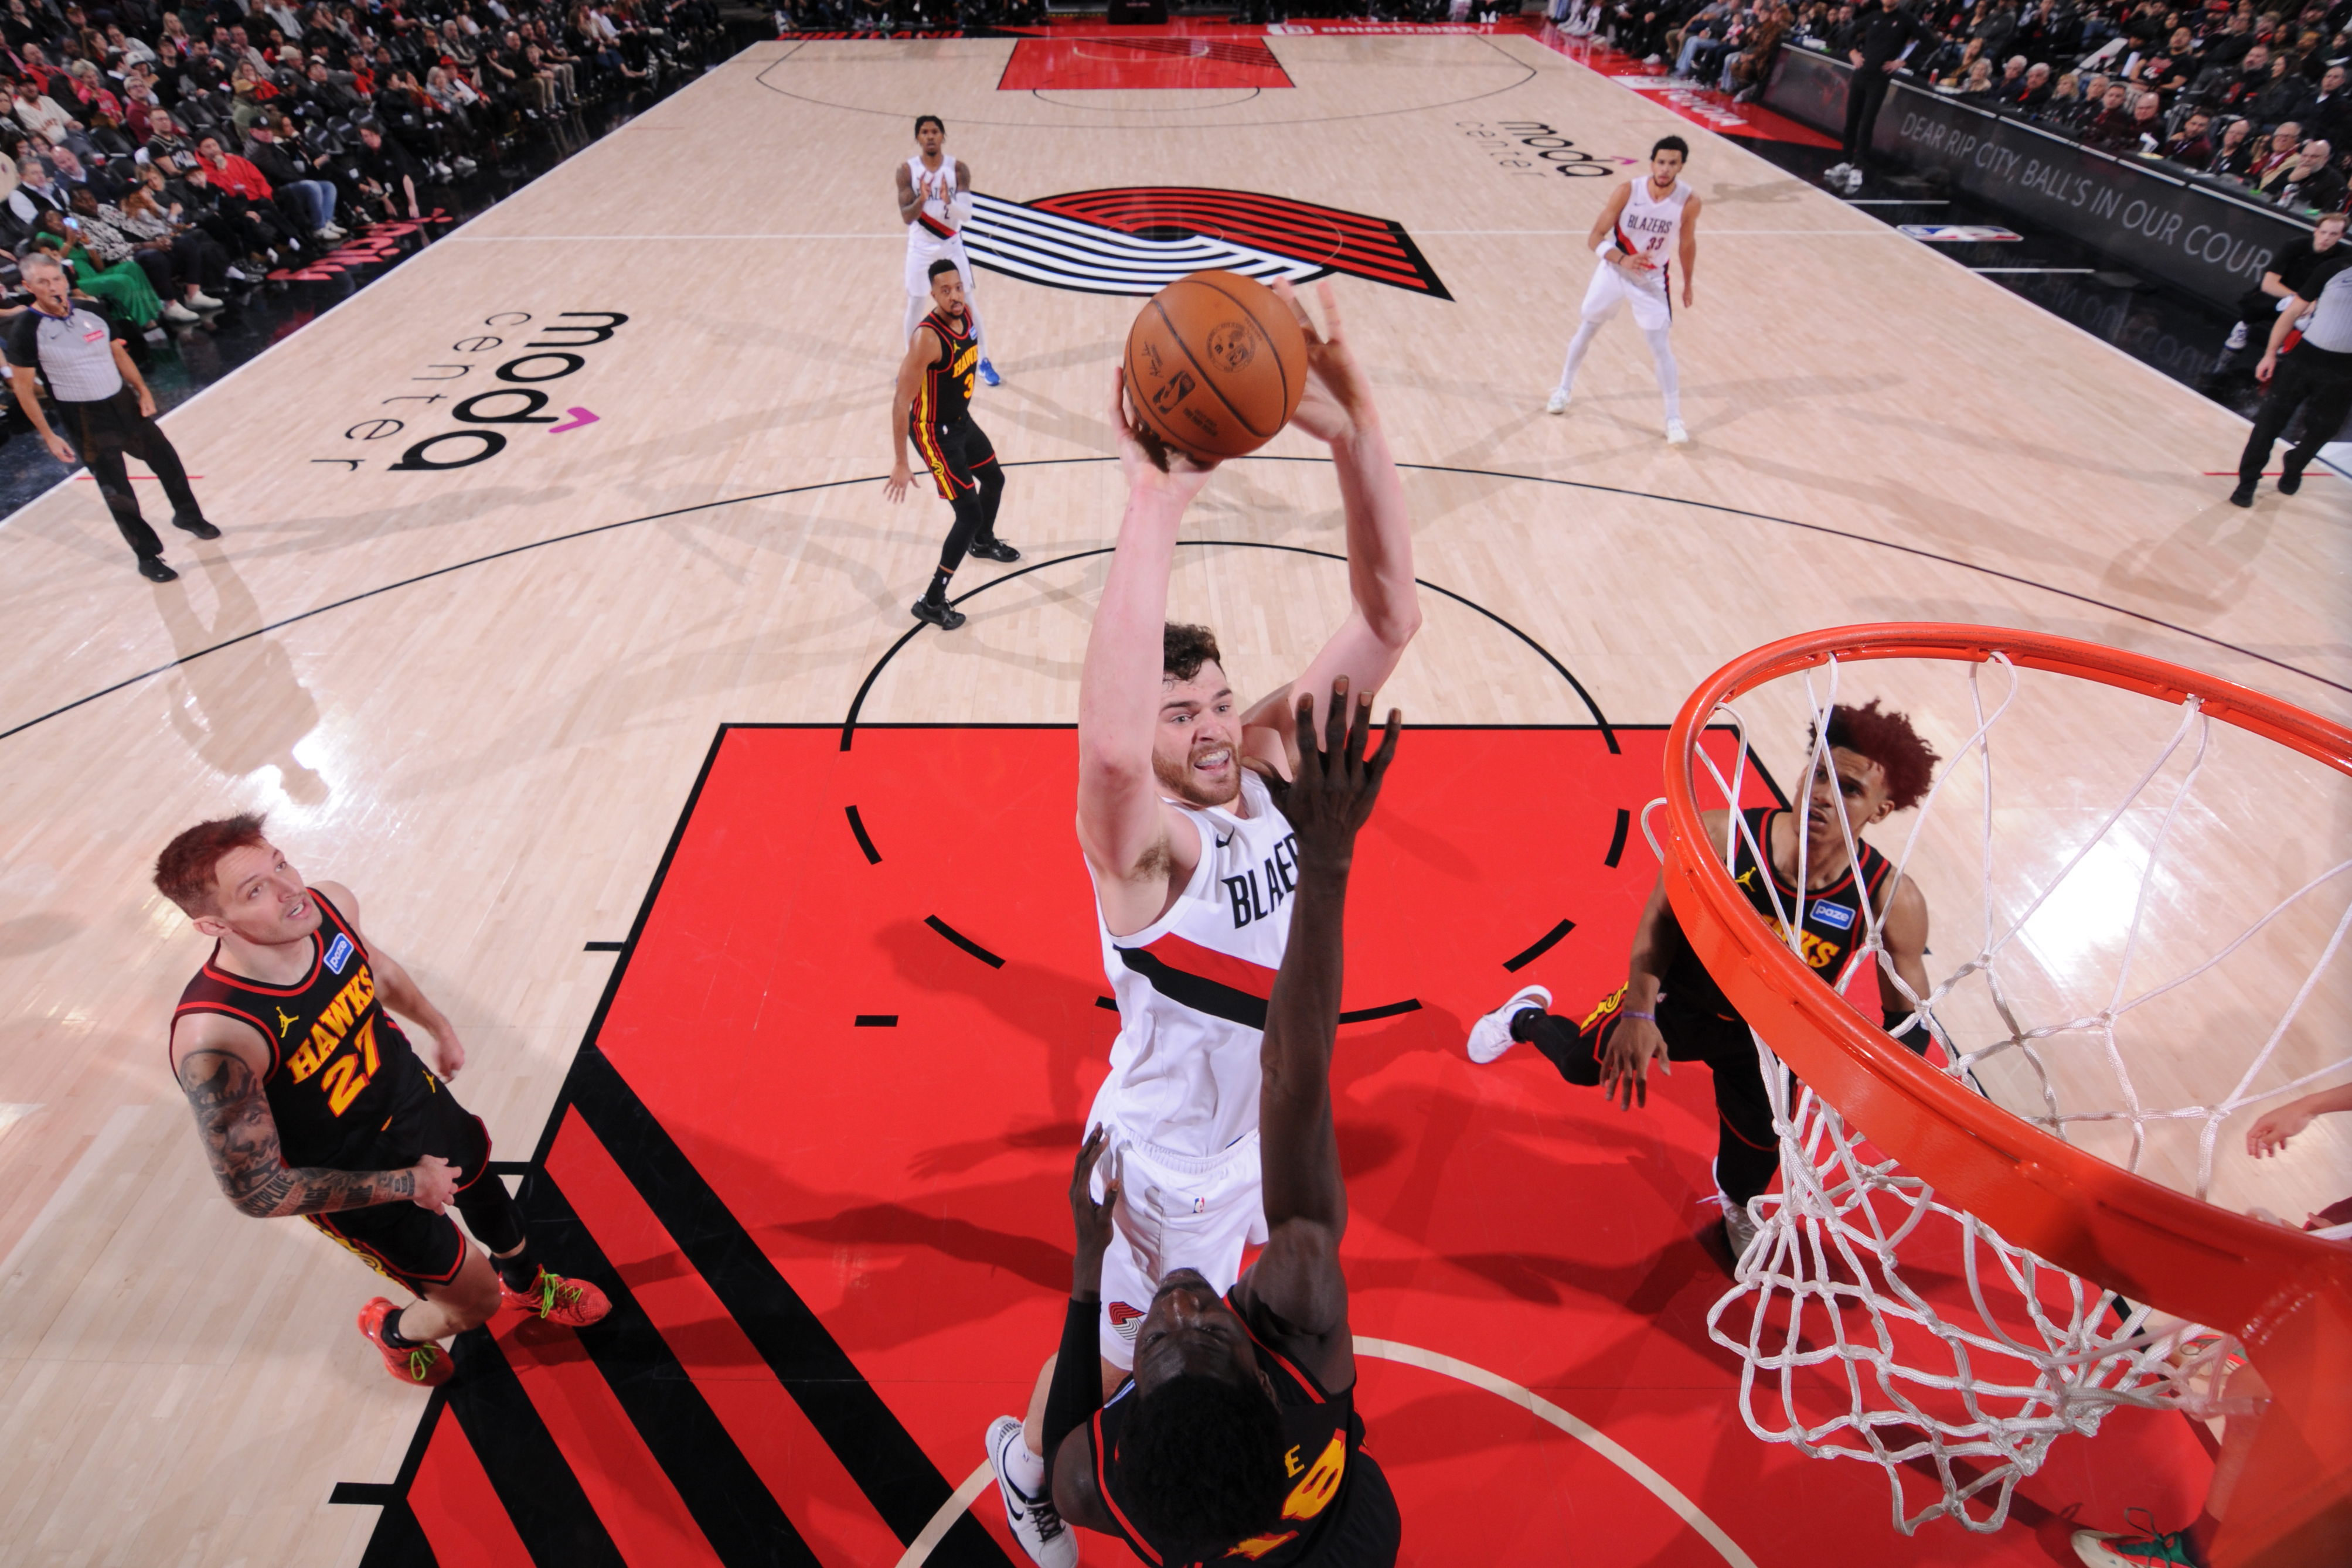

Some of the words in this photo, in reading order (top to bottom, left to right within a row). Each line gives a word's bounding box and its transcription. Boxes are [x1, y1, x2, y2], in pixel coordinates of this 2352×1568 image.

[1497, 121, 1615, 177] moda
[1627, 214, 1673, 234] BLAZERS
[1900, 112, 1946, 148] DEAR
[1943, 129, 1977, 159] RIP
[2021, 159, 2092, 206] BALL'S
[2089, 186, 2123, 220] IN
[2122, 200, 2183, 246] OUR
[2184, 224, 2273, 282] COUR
[310, 312, 532, 471] center
[386, 312, 629, 471] moda
[964, 372, 974, 399] 3
[329, 940, 348, 969] paze
[1815, 905, 1850, 922] paze
[285, 963, 375, 1085] HAWKS
[321, 1010, 381, 1118] 27
